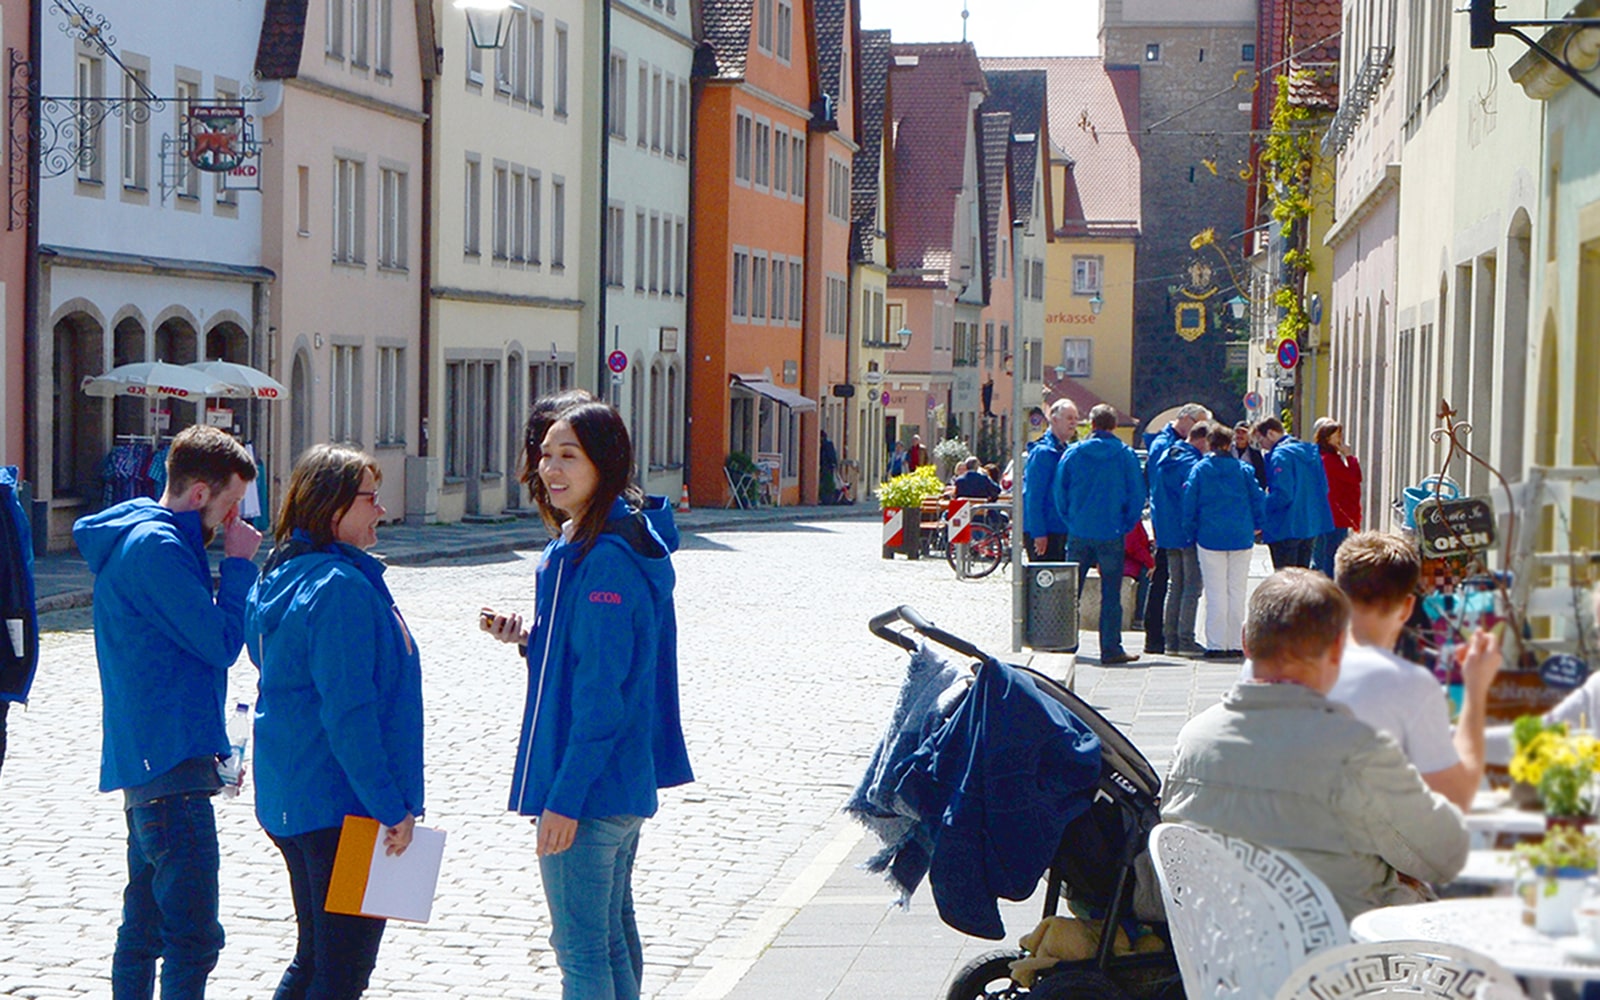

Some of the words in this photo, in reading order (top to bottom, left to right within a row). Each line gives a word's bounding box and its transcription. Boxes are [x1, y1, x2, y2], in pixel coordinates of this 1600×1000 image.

[228, 165, 257, 177] NKD
[1046, 312, 1096, 324] arkasse
[157, 385, 189, 398] NKD
[257, 387, 279, 399] NKD
[1433, 532, 1490, 550] OPEN
